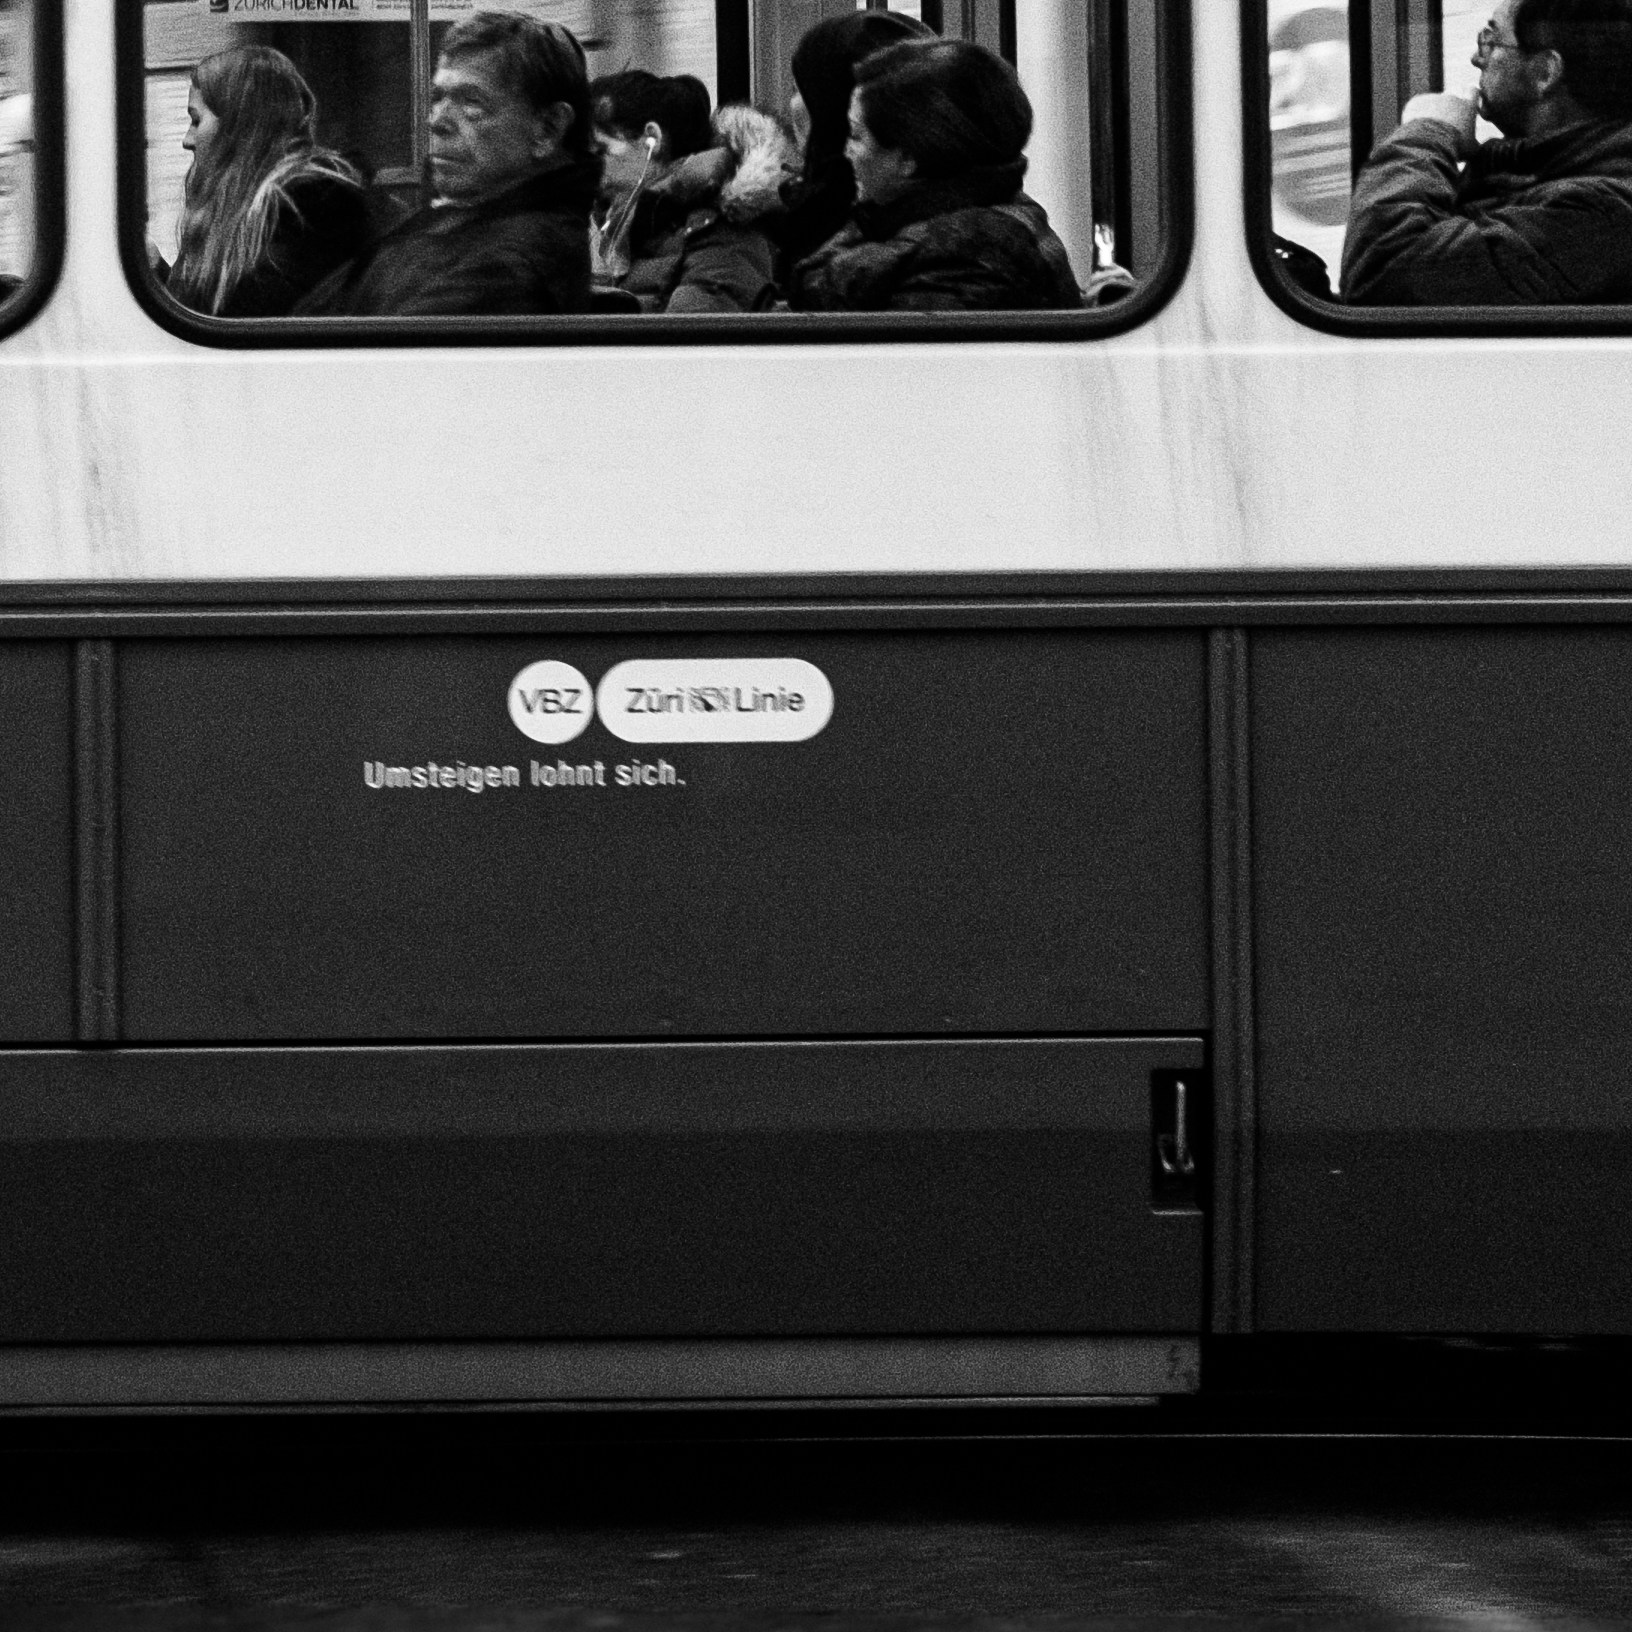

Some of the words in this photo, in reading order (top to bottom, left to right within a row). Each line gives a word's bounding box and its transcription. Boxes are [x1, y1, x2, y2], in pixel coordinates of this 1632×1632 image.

[519, 688, 584, 714] VBZ
[624, 687, 686, 714] Züri
[734, 686, 806, 714] Linie
[363, 760, 521, 795] Umsteigen
[529, 759, 607, 787] lohnt
[614, 758, 687, 787] sich.
